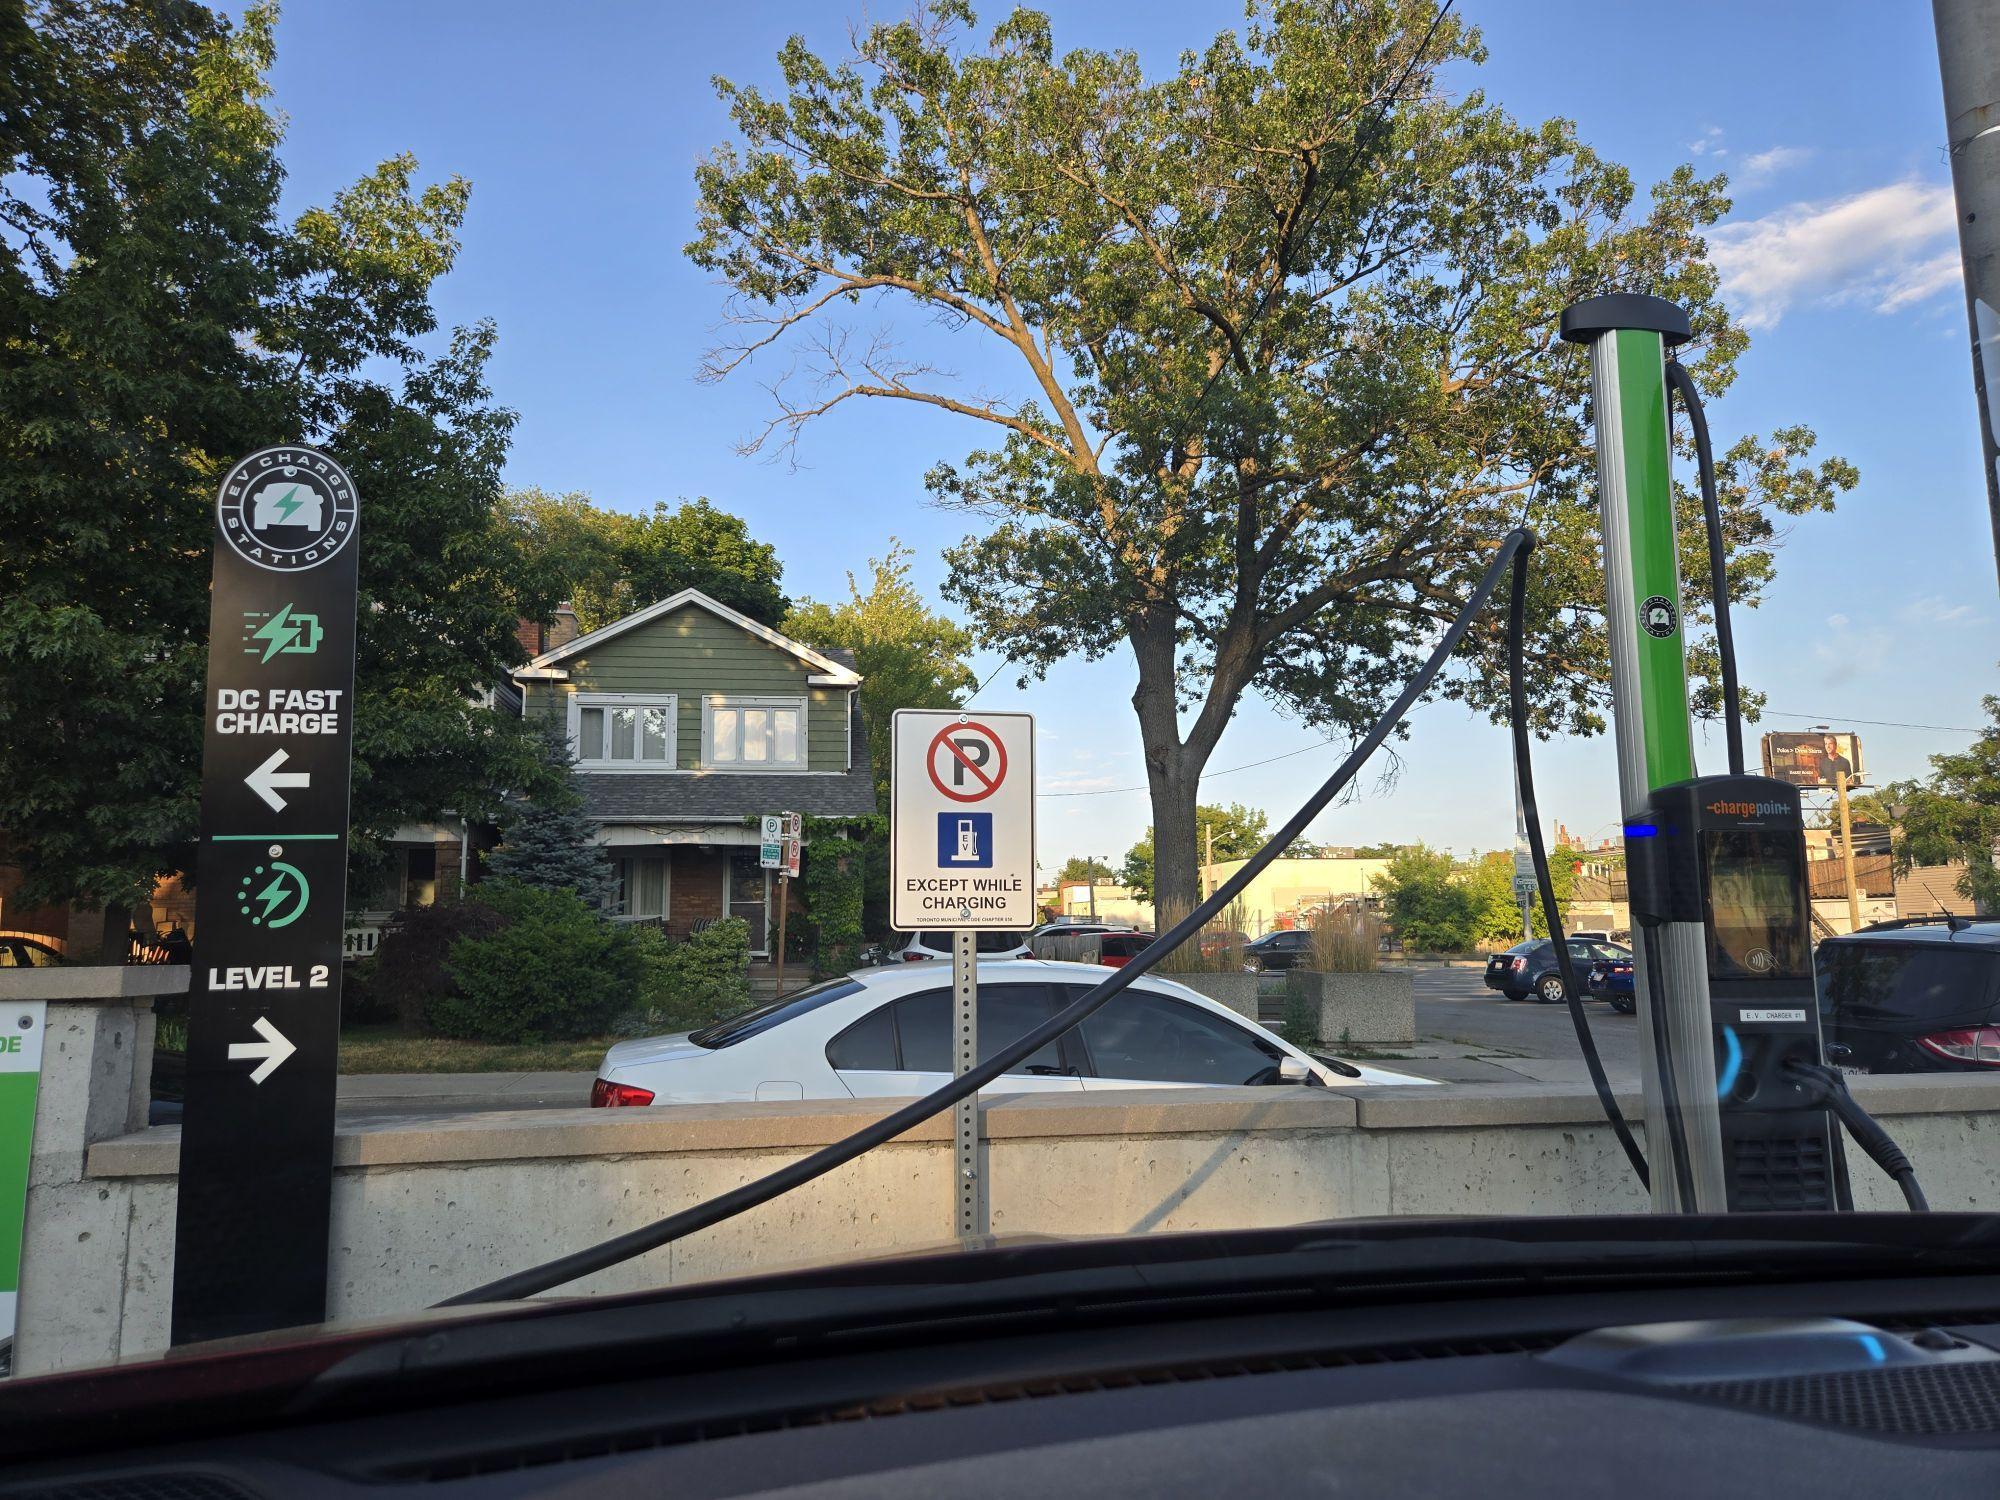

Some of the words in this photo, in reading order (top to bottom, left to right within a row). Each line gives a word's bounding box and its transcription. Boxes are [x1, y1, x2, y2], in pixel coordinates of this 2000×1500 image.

[229, 470, 249, 496] EV
[260, 454, 349, 500] CHARGE
[228, 517, 347, 565] STATIONS
[218, 689, 260, 710] DC
[268, 690, 343, 711] FAST
[216, 712, 339, 734] CHARGE
[1707, 800, 1791, 818] chargepoint
[906, 879, 968, 892] EXCEPT
[973, 879, 1022, 892] WHILE
[922, 896, 1007, 910] CHARGING
[208, 965, 301, 990] LEVEL
[309, 964, 329, 988] 2
